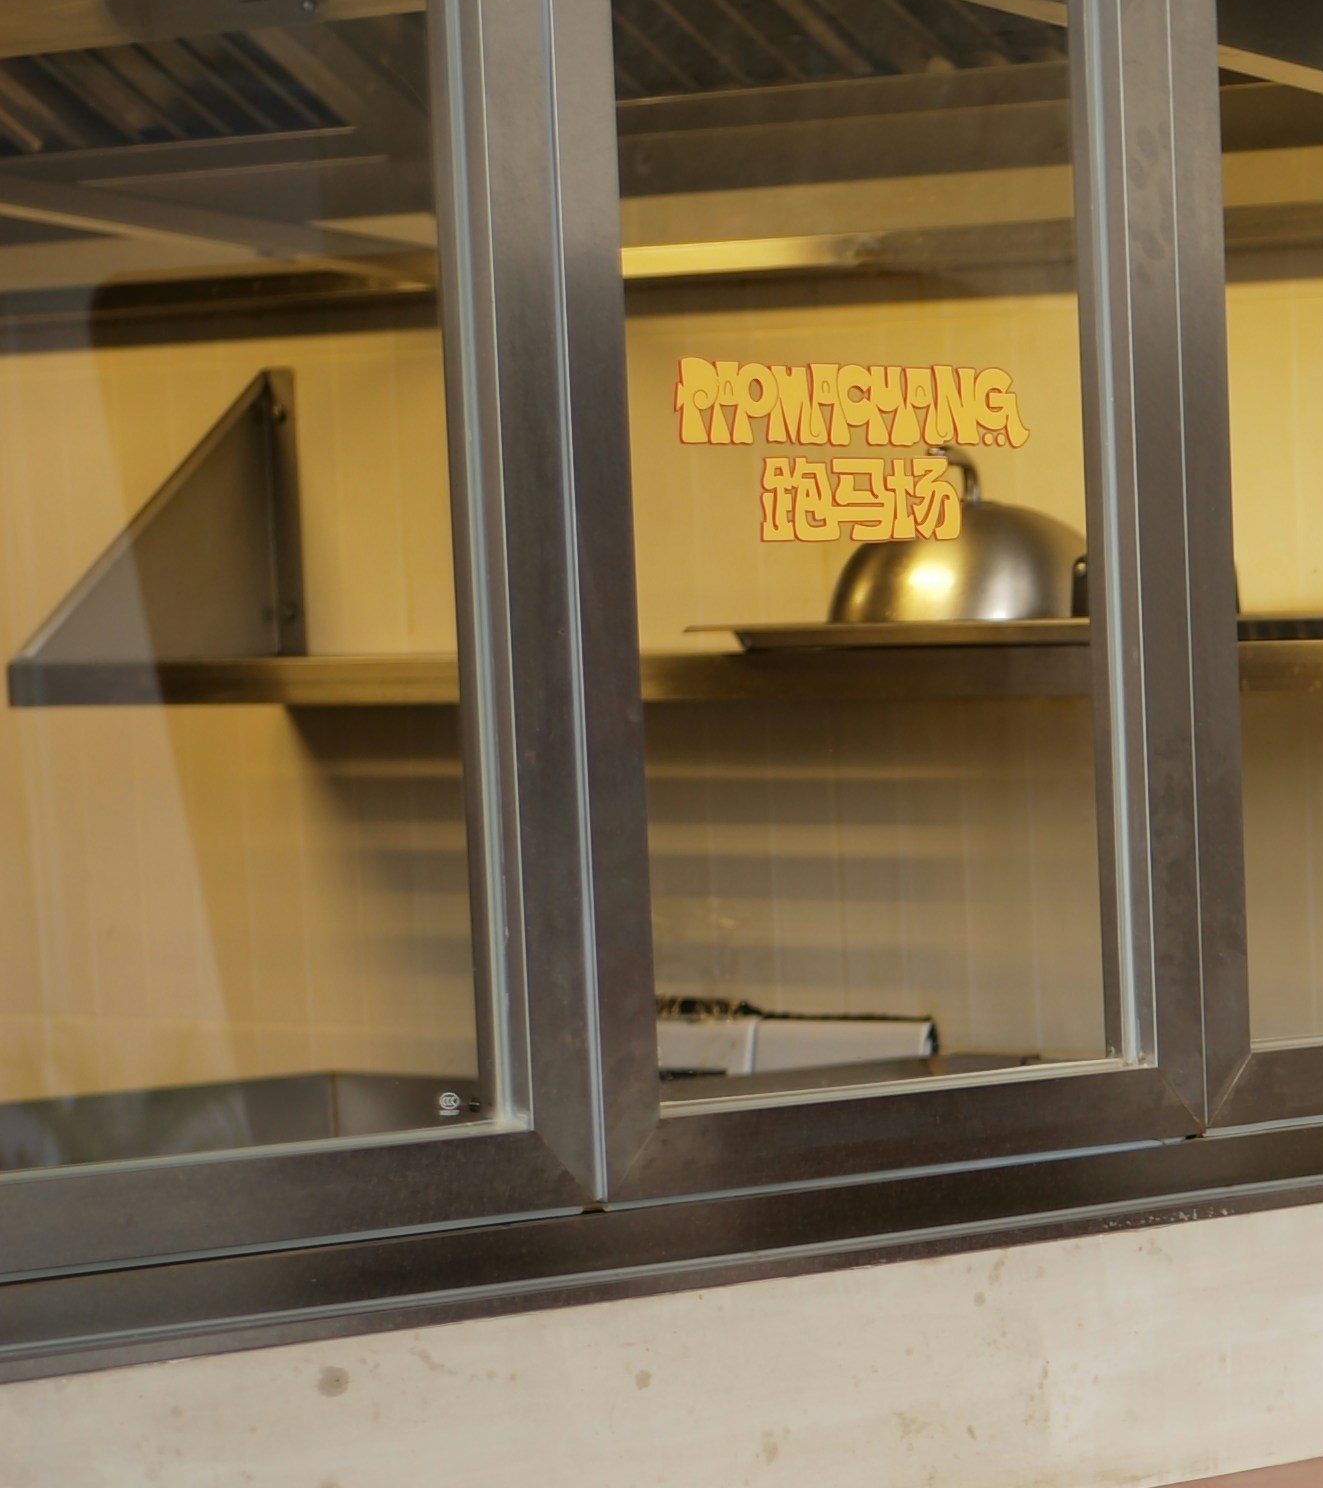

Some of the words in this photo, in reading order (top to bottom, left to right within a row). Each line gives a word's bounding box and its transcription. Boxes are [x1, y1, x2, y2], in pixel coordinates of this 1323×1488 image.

[674, 356, 1030, 448] PAOMACHANG
[760, 456, 961, 542] 跑马场
